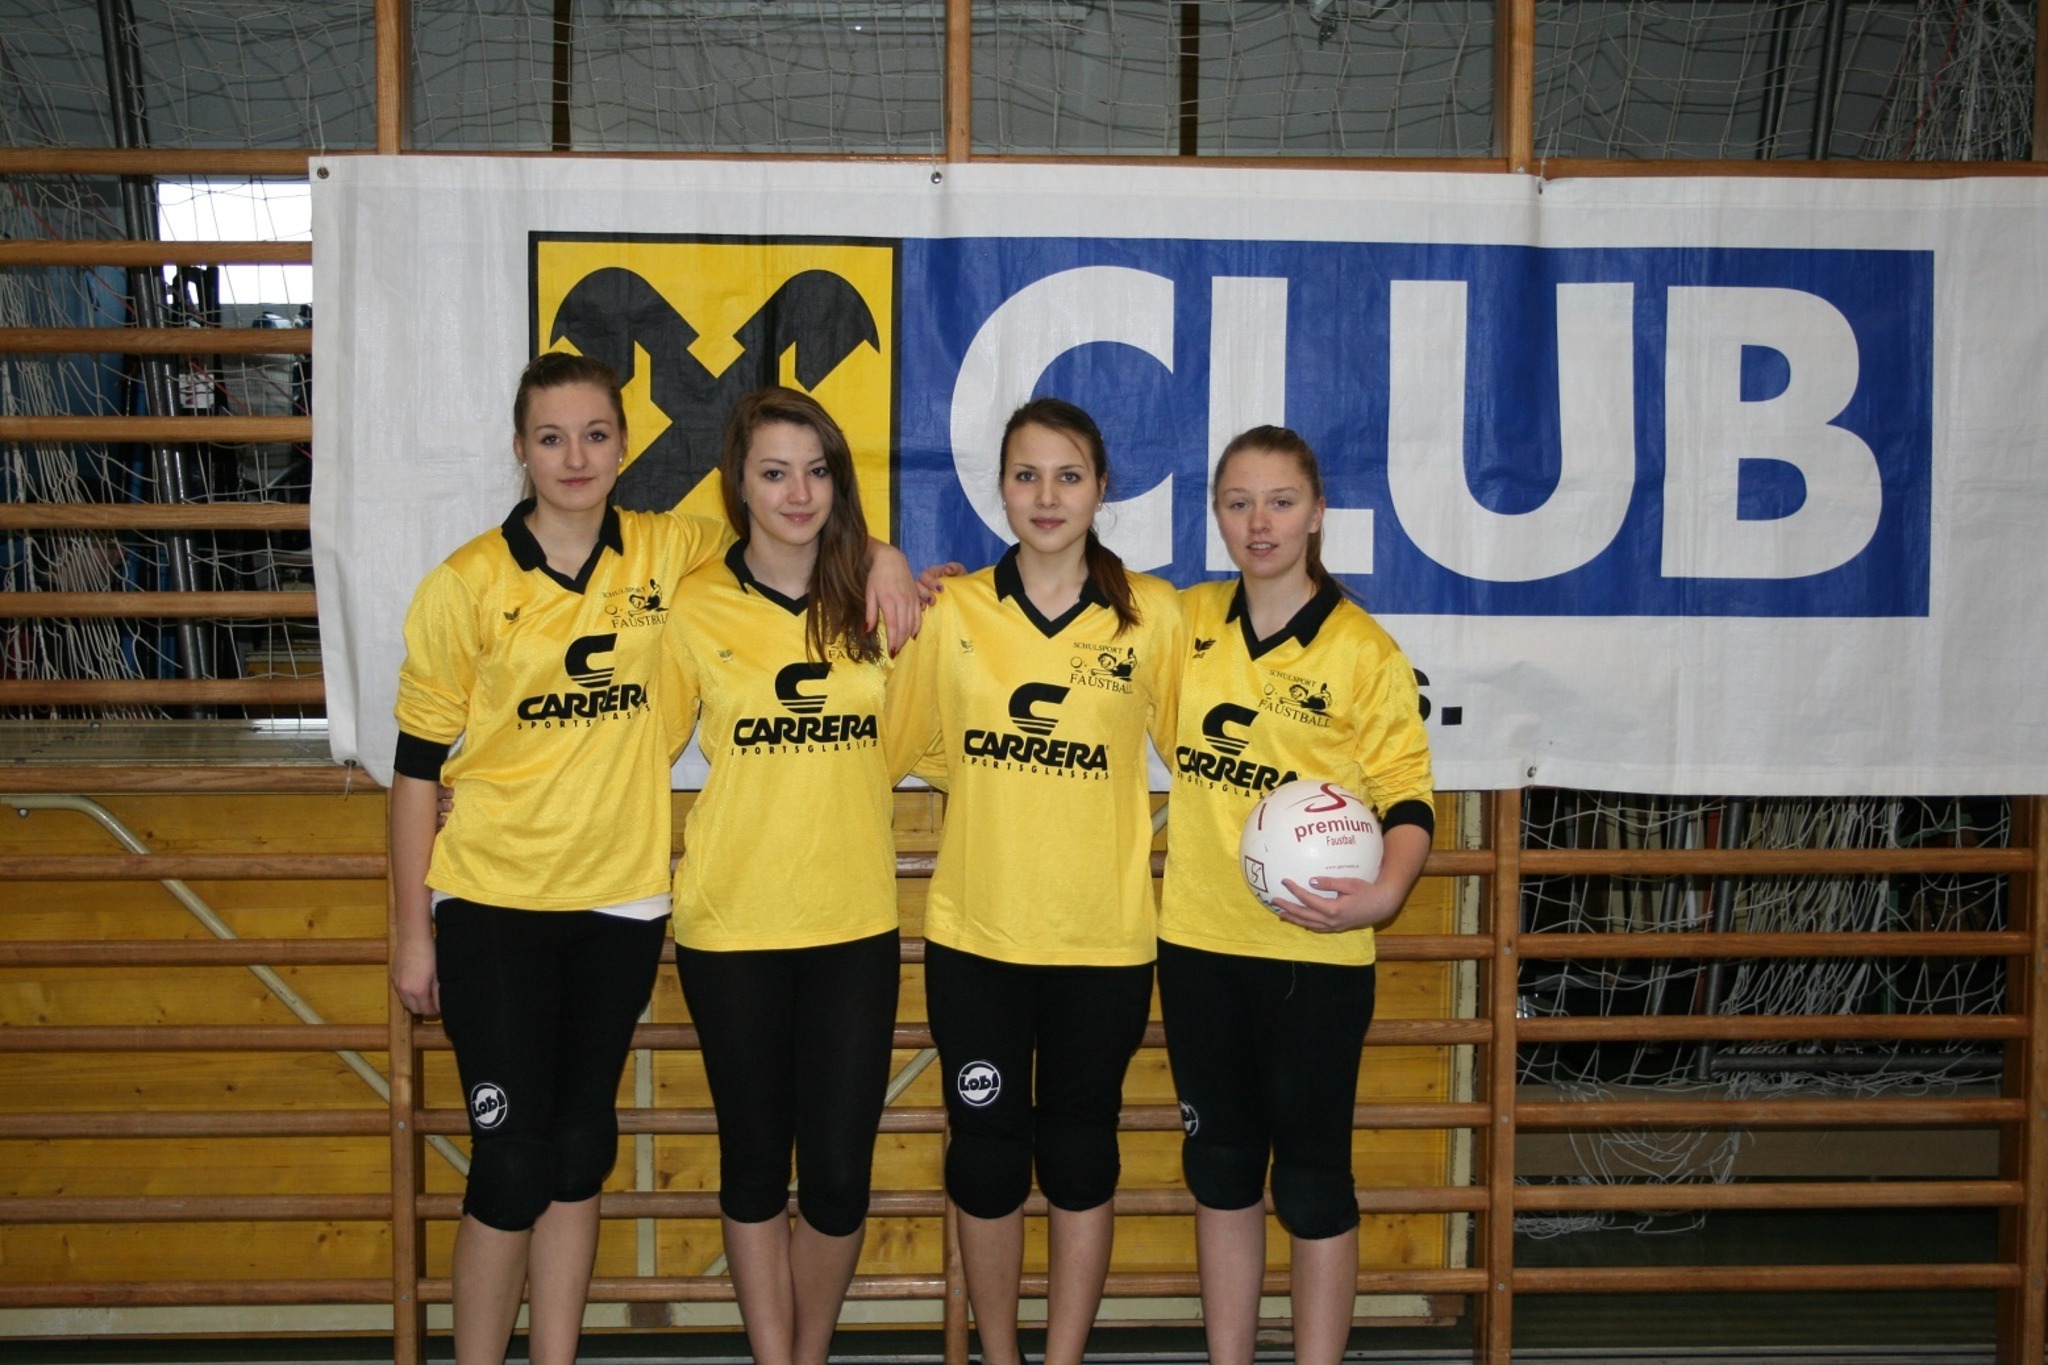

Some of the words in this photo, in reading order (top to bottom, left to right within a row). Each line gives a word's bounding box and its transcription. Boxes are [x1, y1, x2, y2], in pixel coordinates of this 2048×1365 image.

[950, 265, 1883, 582] CLUB
[1073, 641, 1123, 654] SCHULSPORT
[1069, 673, 1133, 694] FAUSTBALL
[1269, 669, 1318, 688] SCHULSPORT
[517, 683, 648, 721] CARRERA
[1258, 699, 1332, 728] FAUSTBALL
[733, 714, 878, 747] CARRERA
[964, 729, 1108, 771] CARRERA
[962, 755, 1109, 780] SPORTSGLASSES
[1175, 745, 1298, 791] CARRERA
[1294, 815, 1374, 843] premium
[1326, 834, 1356, 847] Faustball
